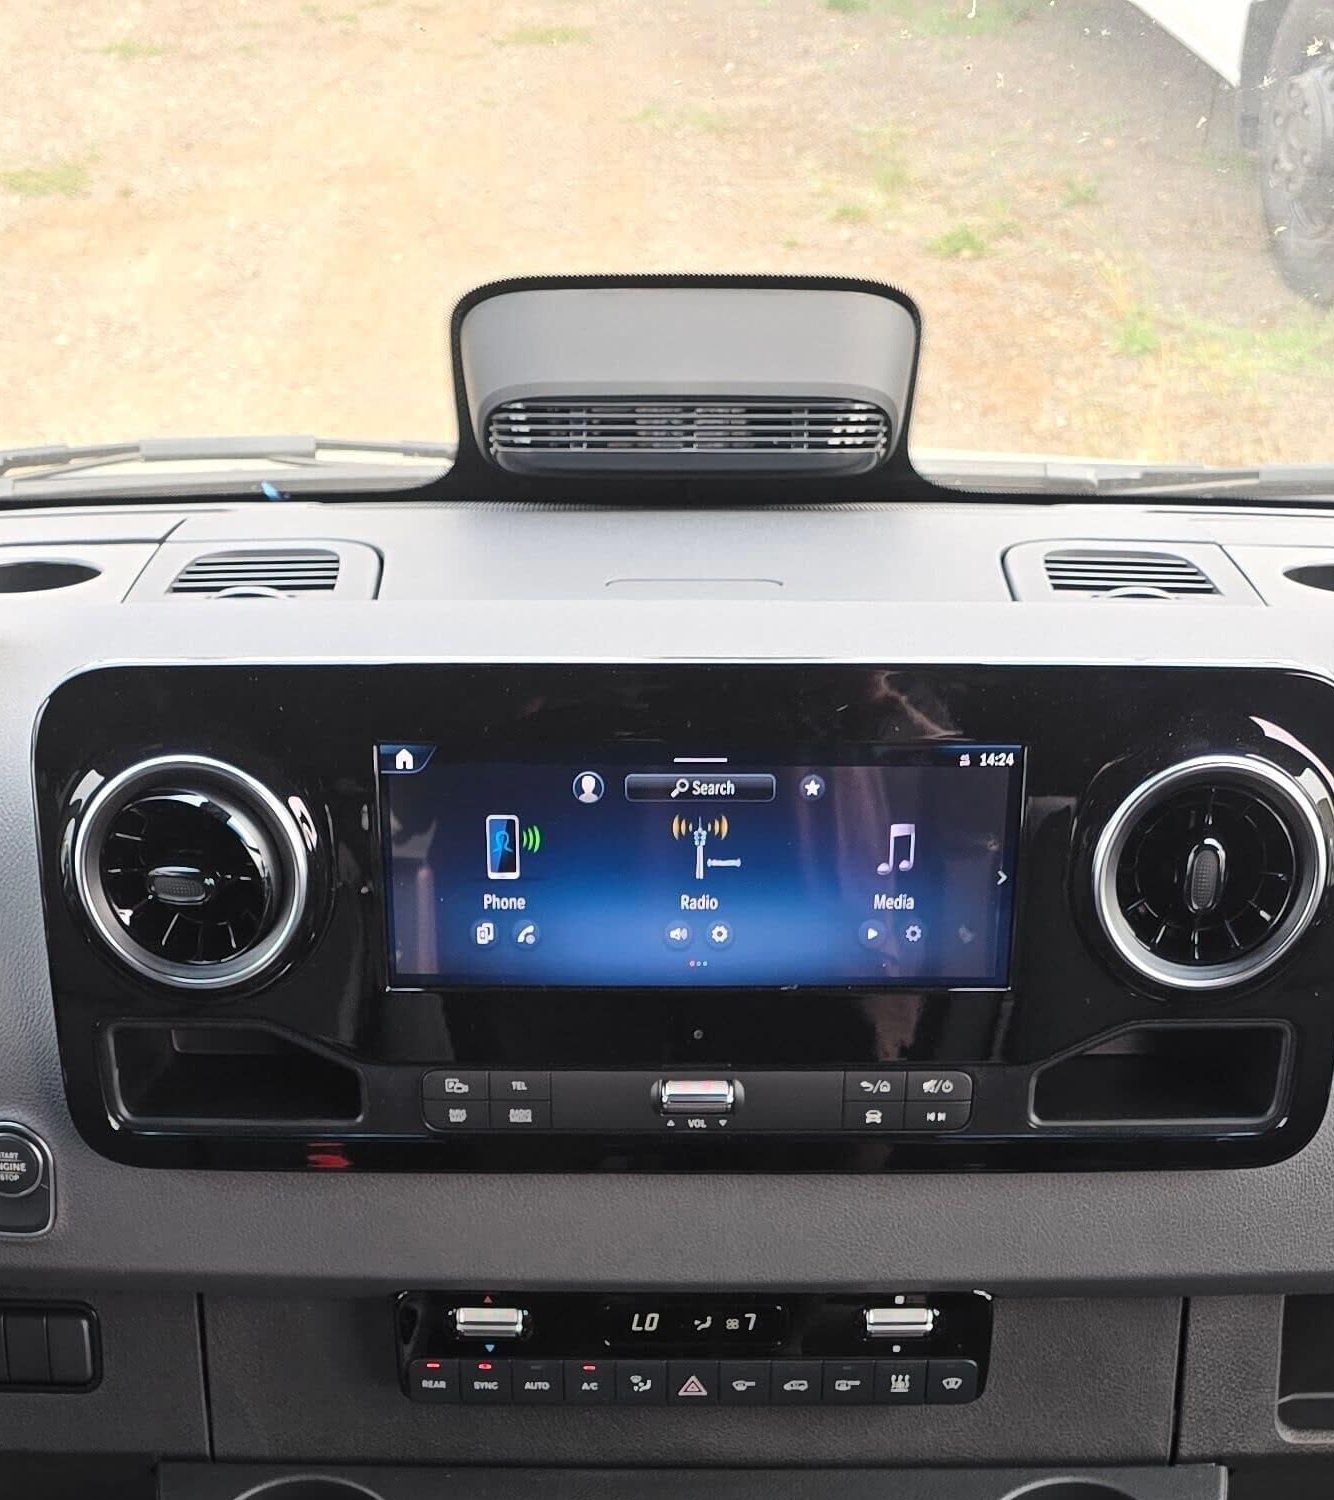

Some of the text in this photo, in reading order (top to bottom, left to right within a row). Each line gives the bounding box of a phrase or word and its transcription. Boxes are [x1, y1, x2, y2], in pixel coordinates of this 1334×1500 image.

[980, 753, 1014, 766] 14:24
[692, 780, 735, 797] Search
[483, 894, 526, 911] Phone
[680, 894, 718, 911] Radio
[874, 894, 914, 911] Media
[512, 1081, 527, 1090] TEL
[687, 1118, 707, 1128] VOL
[0, 1174, 20, 1182] STOP
[632, 1313, 660, 1331] LO
[744, 1313, 757, 1331] 7
[421, 1379, 447, 1389] REAR
[473, 1381, 499, 1390] SYNC
[524, 1381, 550, 1390] AUTO
[581, 1382, 599, 1391] A/C
